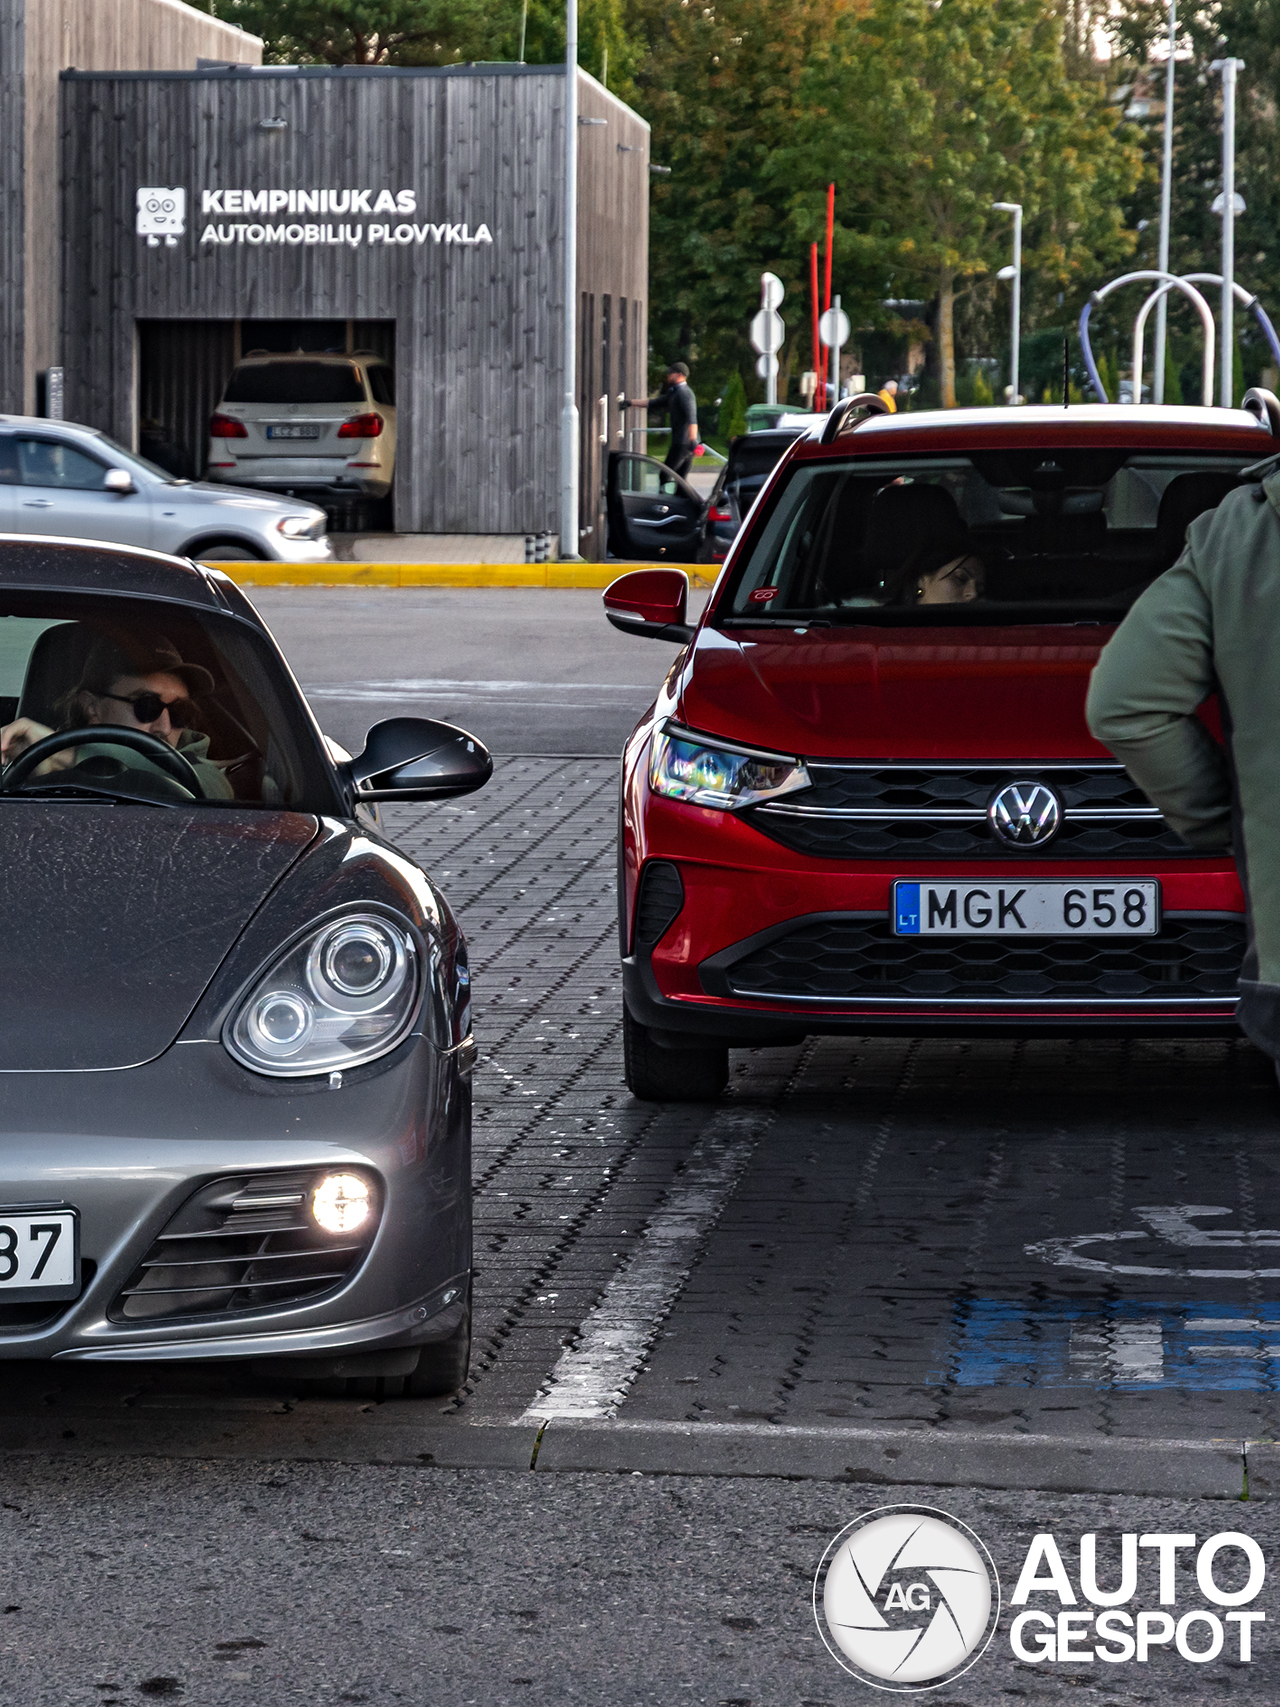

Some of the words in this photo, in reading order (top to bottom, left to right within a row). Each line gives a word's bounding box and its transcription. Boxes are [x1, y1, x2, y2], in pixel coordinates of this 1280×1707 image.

[201, 189, 417, 214] KEMPINIUKAS
[200, 223, 363, 247] AUTOMOBILIŲ
[369, 223, 493, 243] PLOVYKLA
[899, 914, 918, 926] LT
[927, 888, 1028, 929] MGK
[1063, 888, 1147, 929] 658
